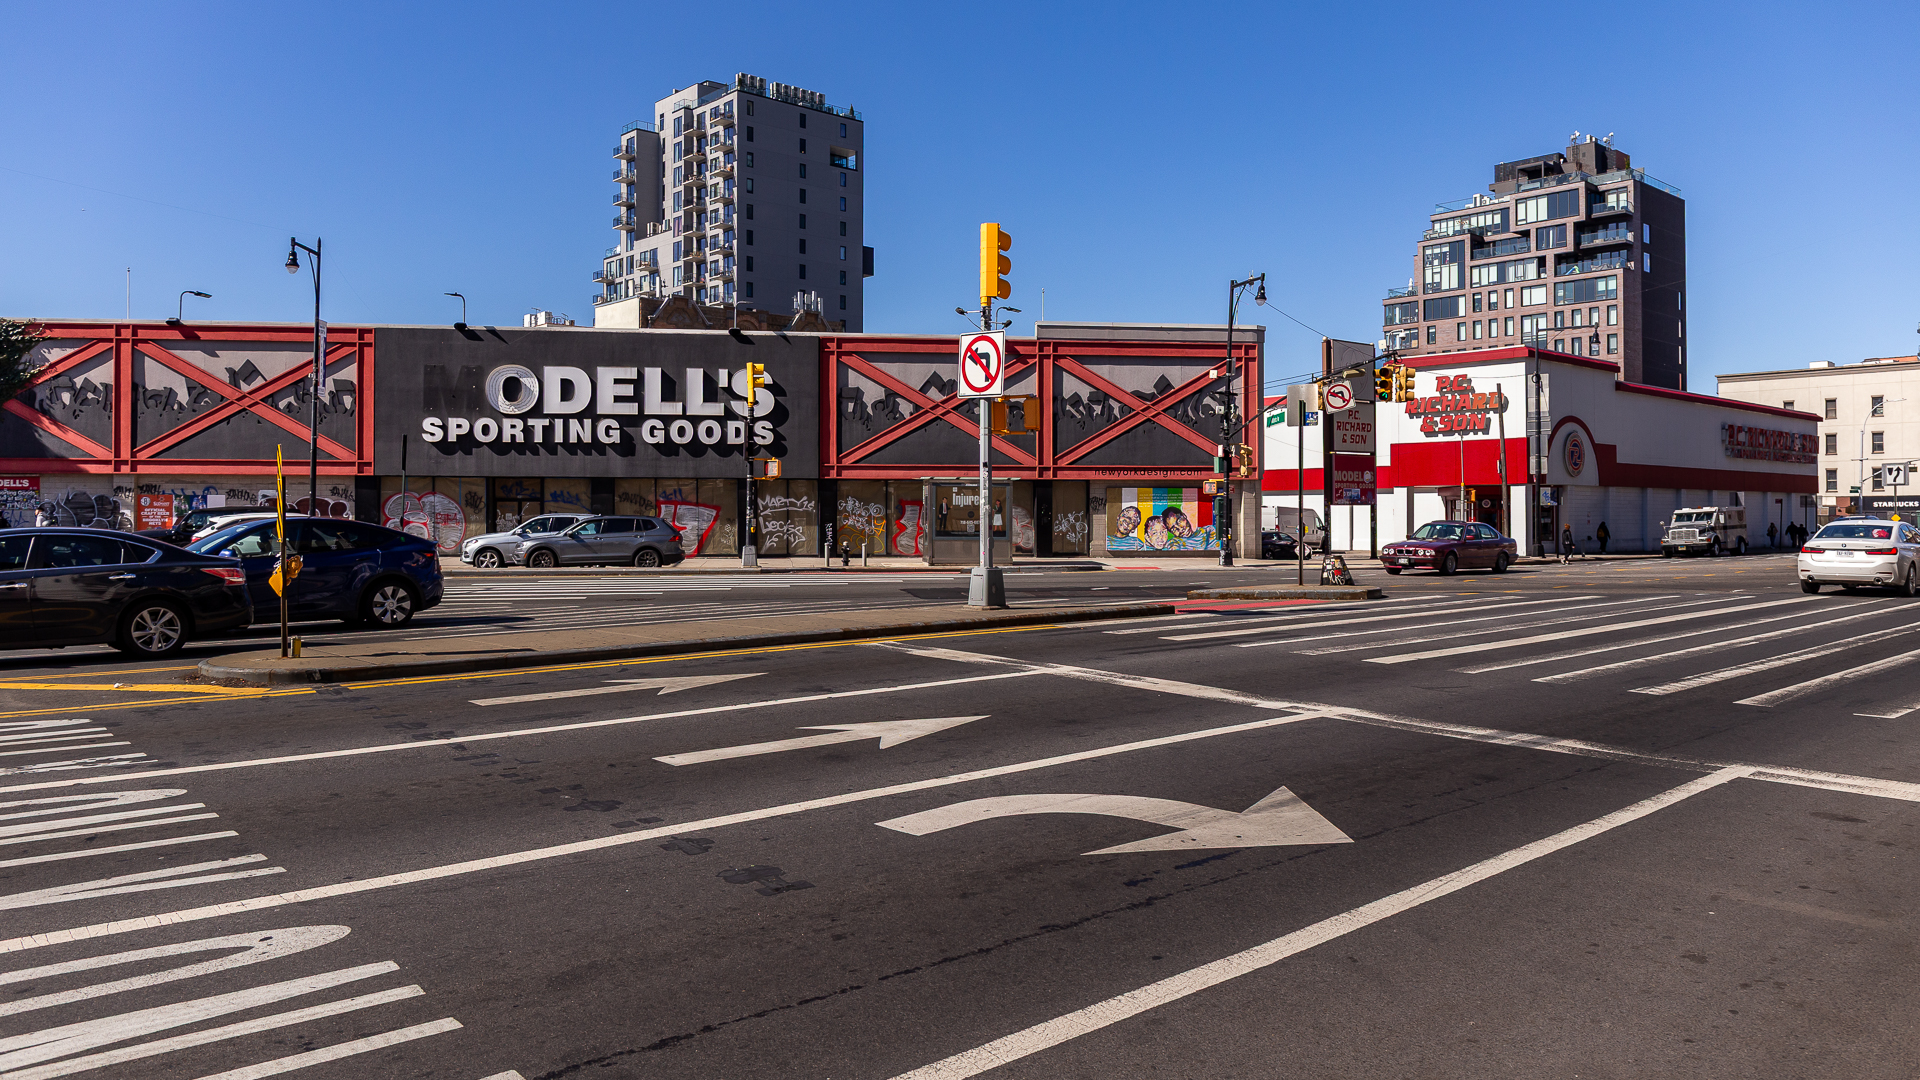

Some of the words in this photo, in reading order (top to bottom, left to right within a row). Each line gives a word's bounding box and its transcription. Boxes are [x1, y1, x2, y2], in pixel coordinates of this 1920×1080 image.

[1436, 374, 1471, 392] P.C.
[1405, 391, 1504, 414] RICHARD
[1347, 410, 1361, 420] P.C.
[1420, 416, 1434, 432] &
[1438, 413, 1486, 432] SON
[421, 416, 621, 443] SPORTING
[641, 418, 775, 445] GOODS
[1336, 421, 1372, 433] RICHARD
[1341, 433, 1348, 444] &
[1350, 434, 1368, 445] SON
[1094, 468, 1202, 478] newyorkdesign.com
[952, 493, 980, 508] Injure
